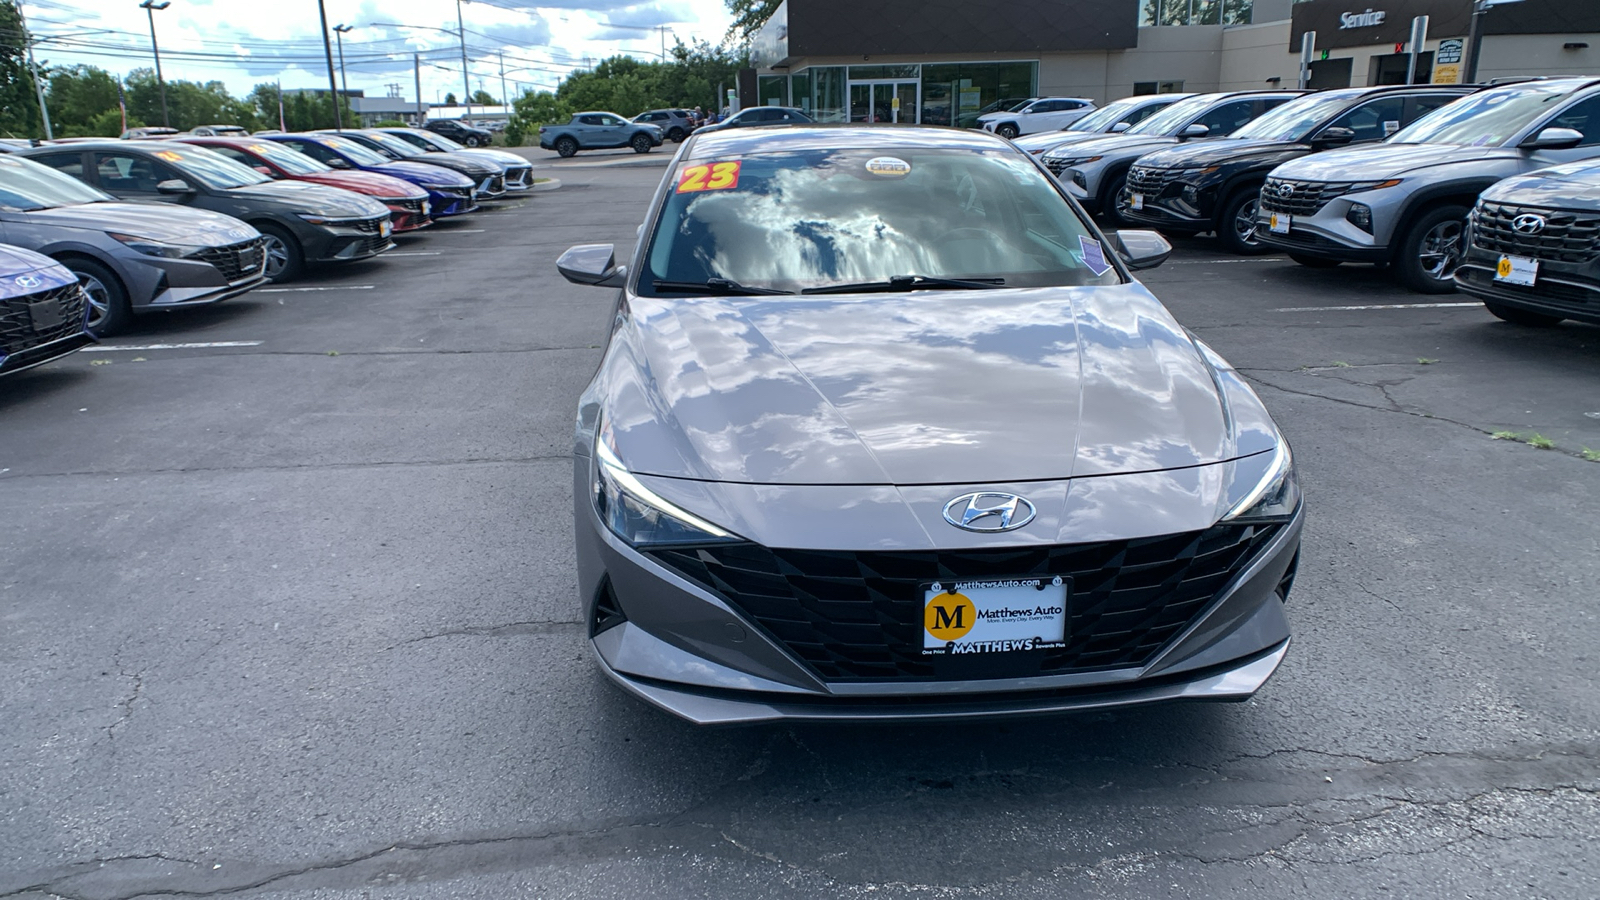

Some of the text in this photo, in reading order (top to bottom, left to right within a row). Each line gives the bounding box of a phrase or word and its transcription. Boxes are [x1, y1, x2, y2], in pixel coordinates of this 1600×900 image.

[1339, 8, 1385, 29] Service
[679, 161, 738, 191] 23
[1500, 262, 1511, 274] M
[954, 579, 1041, 590] MatthewsAuto.com
[931, 604, 966, 629] M
[977, 605, 1063, 620] Matthews Auto
[951, 639, 1034, 655] MATTHEWS
